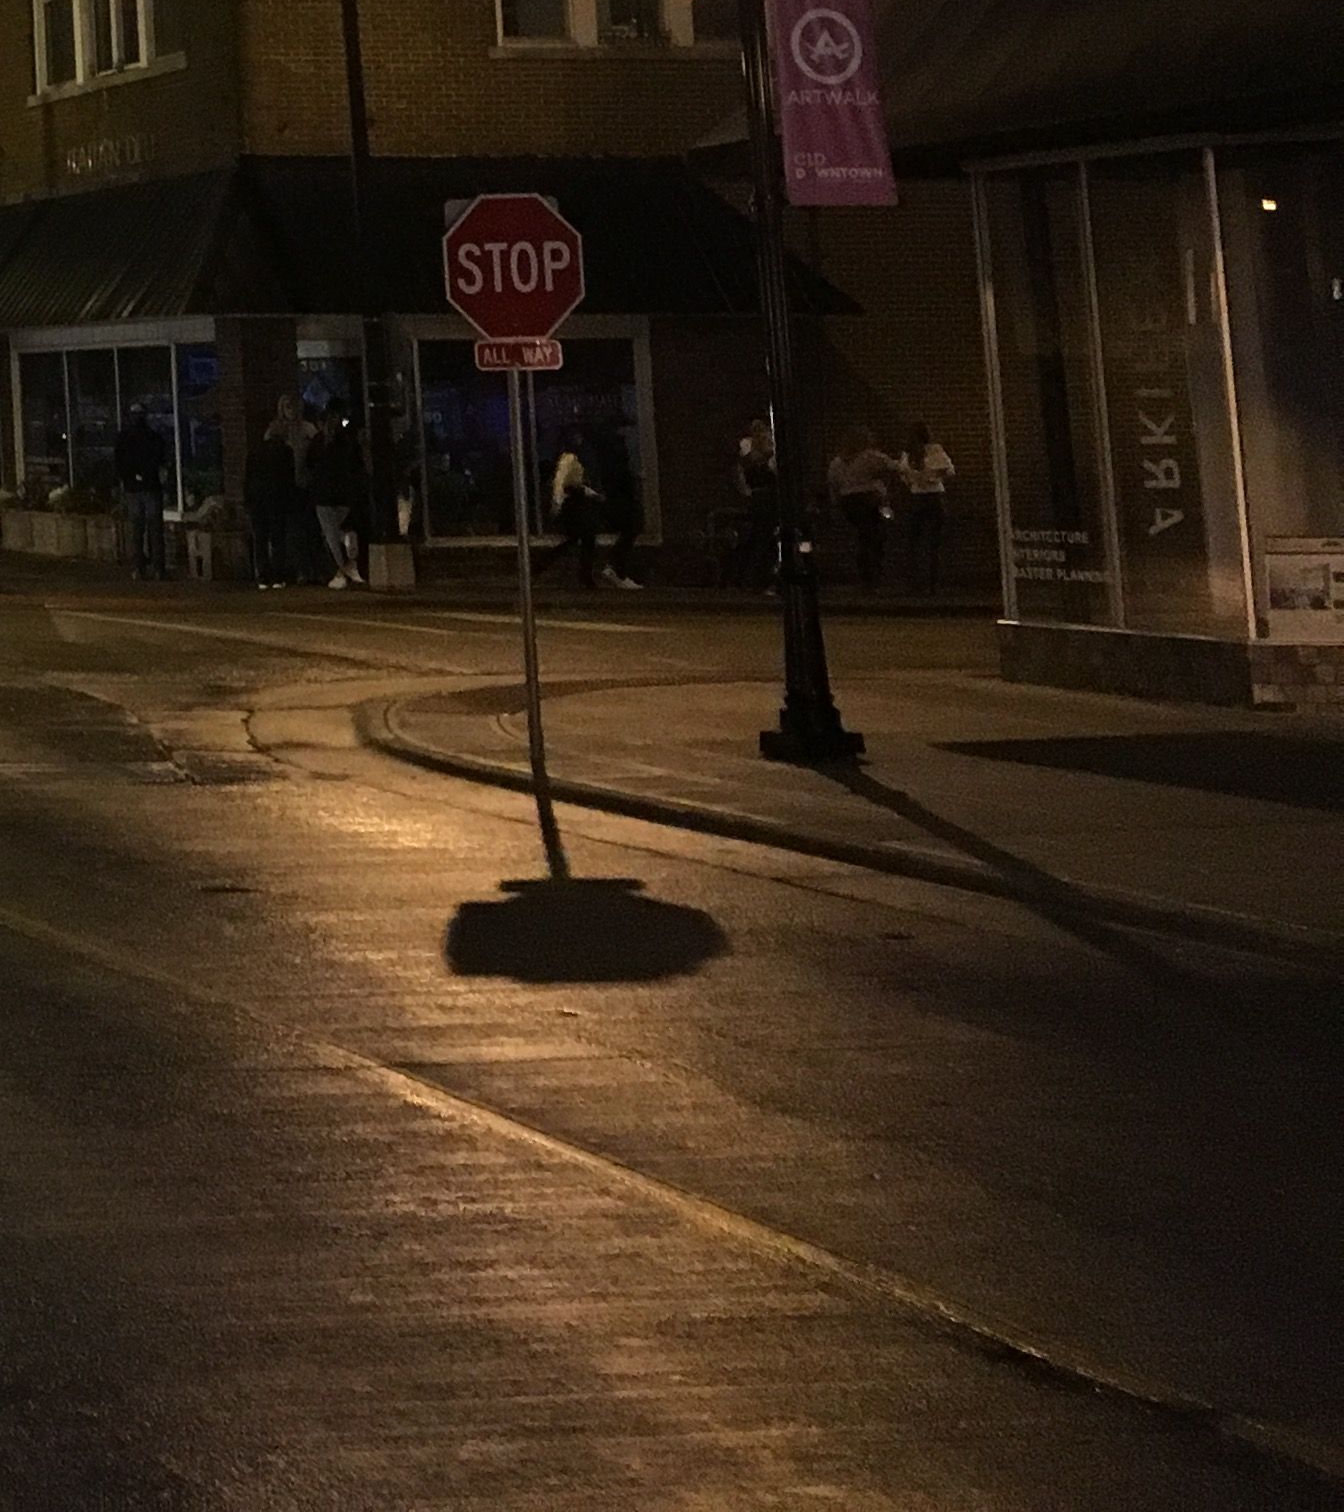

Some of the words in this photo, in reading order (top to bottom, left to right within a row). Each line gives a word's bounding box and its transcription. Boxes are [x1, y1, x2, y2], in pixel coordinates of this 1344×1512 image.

[788, 88, 880, 105] ARTWALK
[795, 167, 884, 180] DWNTOWN
[457, 240, 572, 295] STOP
[483, 347, 511, 365] ALL
[522, 344, 554, 364] WAY
